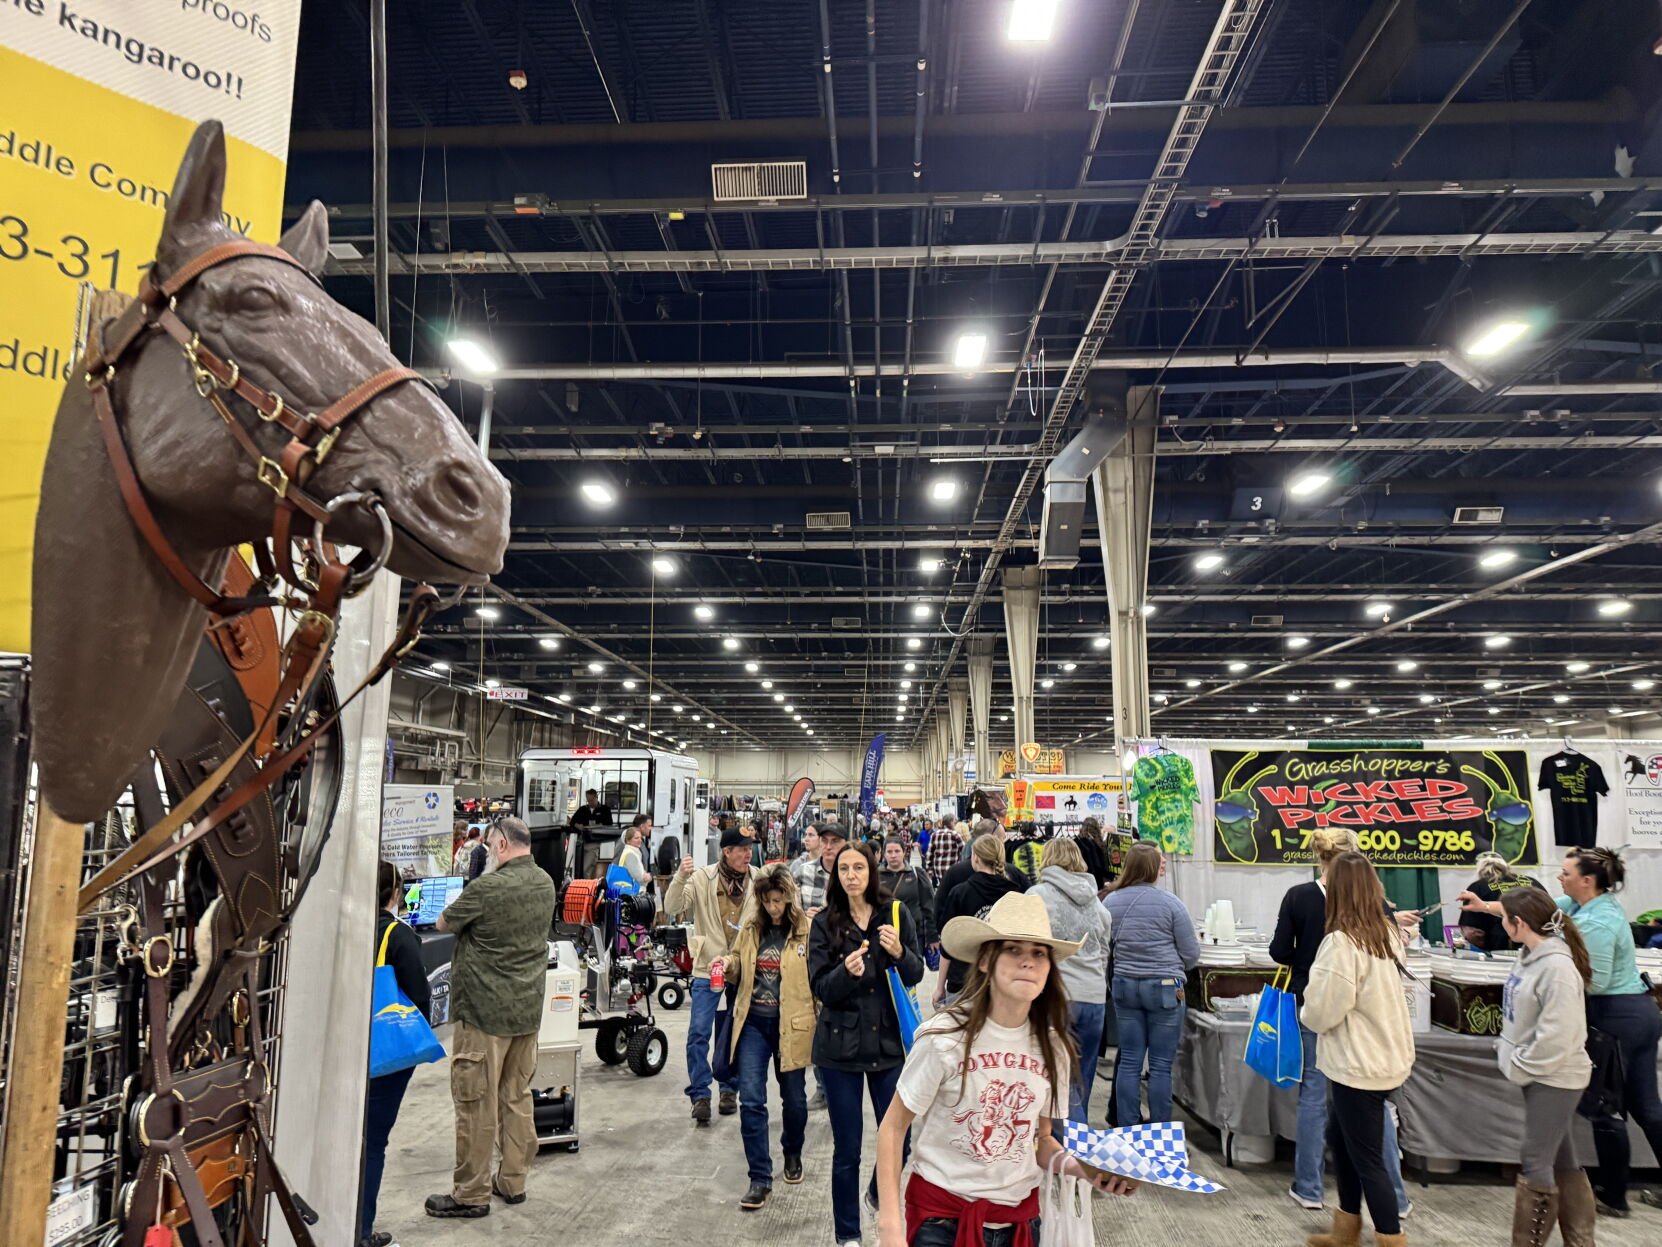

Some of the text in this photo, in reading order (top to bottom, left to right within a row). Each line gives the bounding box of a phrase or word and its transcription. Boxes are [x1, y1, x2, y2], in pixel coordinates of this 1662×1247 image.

[59, 1, 243, 100] kangaroo!!
[89, 162, 250, 235] Comny
[1251, 496, 1262, 511] 3
[1285, 753, 1451, 781] Grasshopper's
[1052, 782, 1076, 790] Come
[1080, 782, 1100, 790] Ride
